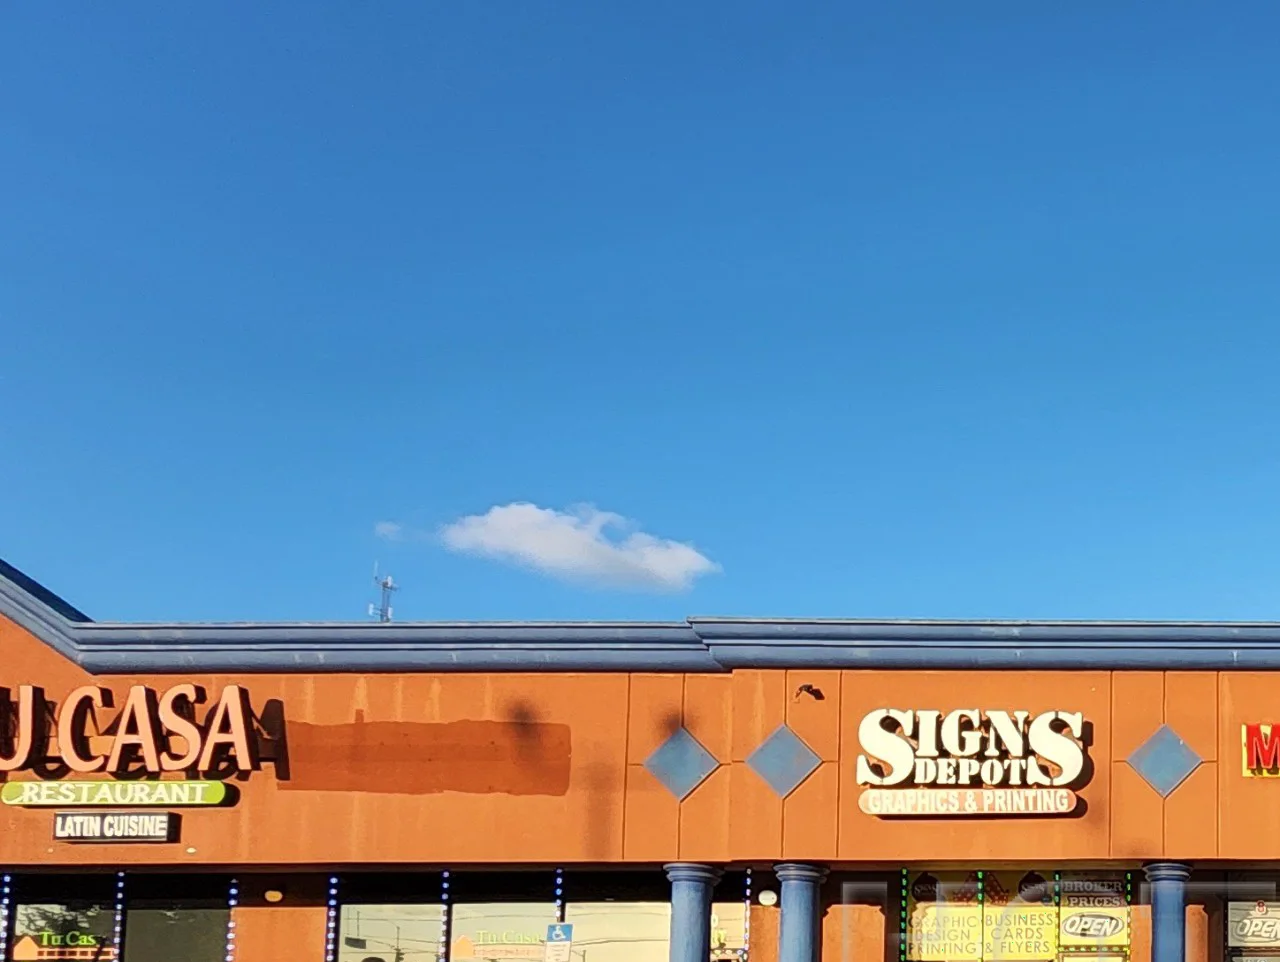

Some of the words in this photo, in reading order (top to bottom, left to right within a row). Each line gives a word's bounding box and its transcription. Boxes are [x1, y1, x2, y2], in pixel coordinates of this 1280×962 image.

[57, 683, 253, 772] CASA
[856, 708, 1084, 787] SIGNS
[914, 758, 1028, 786] DEPOT
[10, 780, 210, 804] RESTAURANT
[867, 791, 960, 813] GRAPHICS
[983, 790, 1069, 812] PRINTING
[56, 814, 99, 837] LATIN
[103, 813, 168, 837] CUISINE
[1063, 881, 1123, 892] BROKER
[1068, 896, 1121, 907] PRICES
[909, 915, 977, 929] GRAPHIC
[985, 913, 1054, 928] BUSINESS
[1064, 916, 1118, 936] OPEN
[66, 931, 97, 946] Cas
[914, 928, 971, 942] DESIGN
[990, 927, 1044, 941] CARDS
[908, 943, 977, 956] PRINTING
[984, 942, 994, 954] &
[1000, 941, 1051, 954] FLYERS
